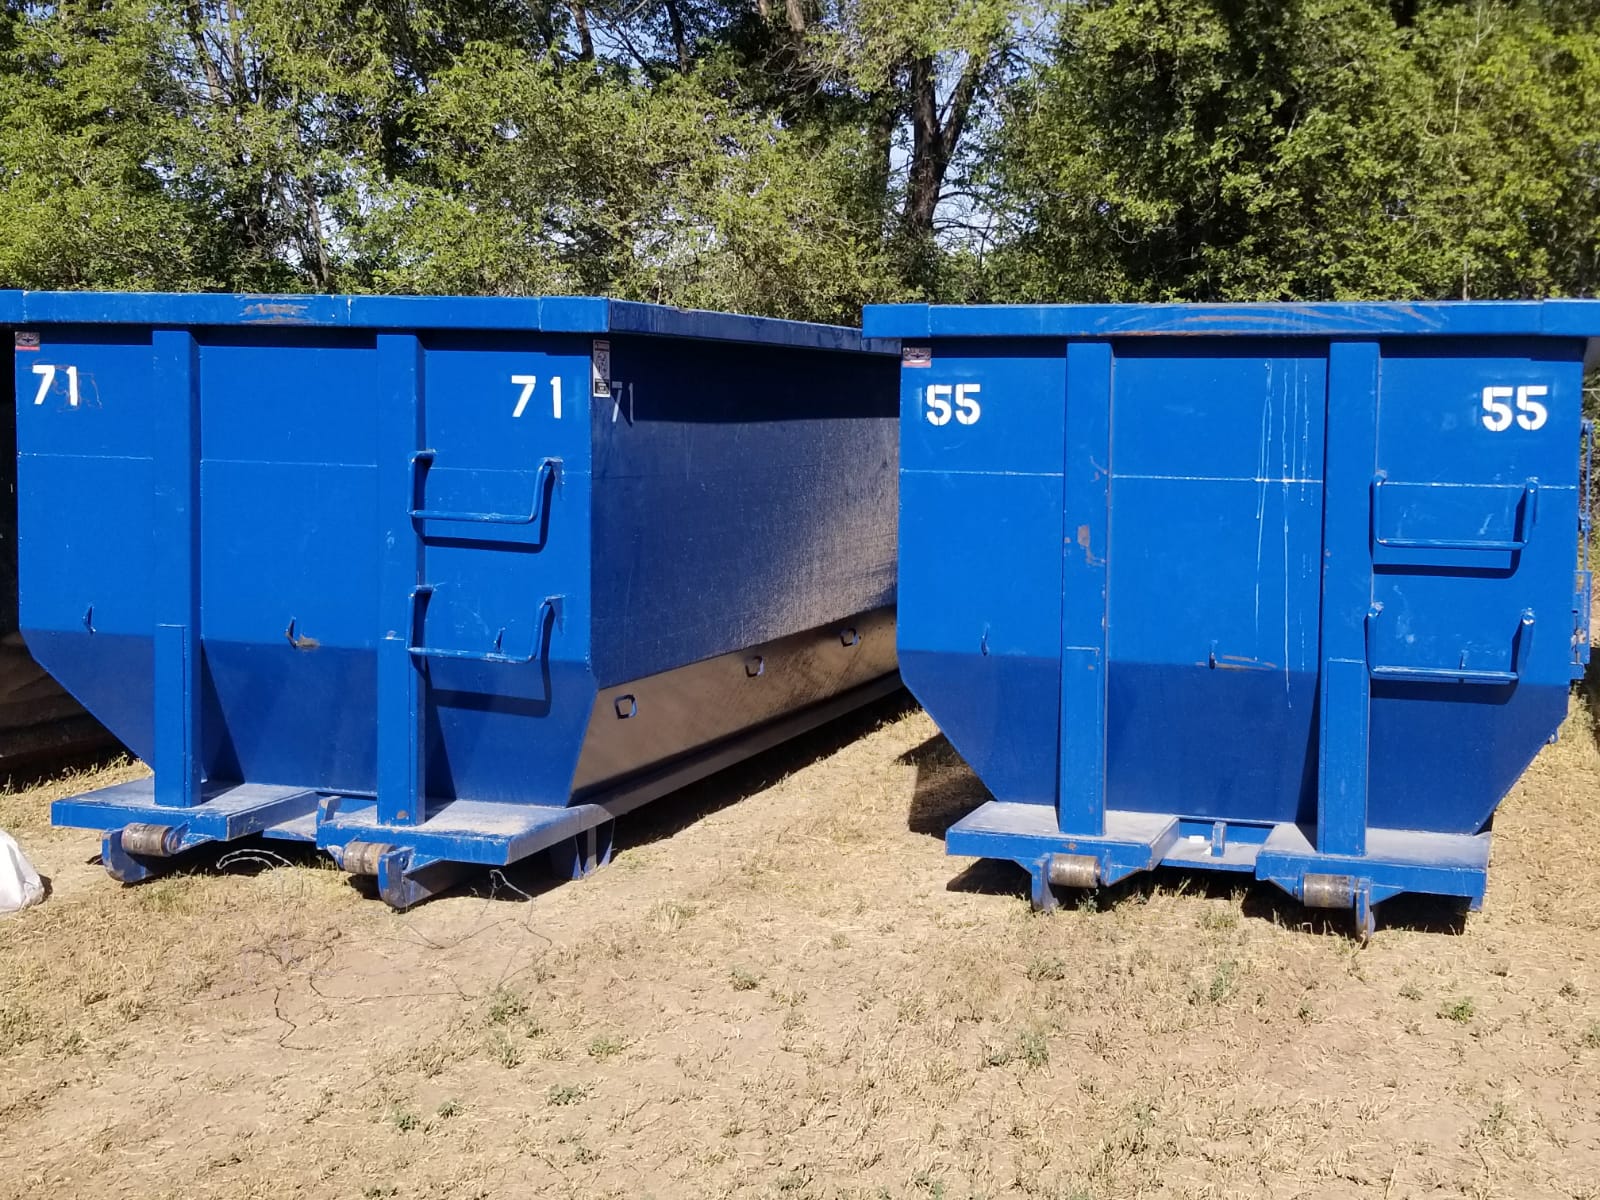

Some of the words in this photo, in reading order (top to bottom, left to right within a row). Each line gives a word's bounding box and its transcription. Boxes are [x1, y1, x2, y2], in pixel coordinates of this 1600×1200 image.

[32, 364, 79, 406] 71
[511, 375, 562, 419] 71
[611, 381, 634, 423] 71
[926, 383, 981, 426] 55
[1482, 385, 1548, 432] 55
